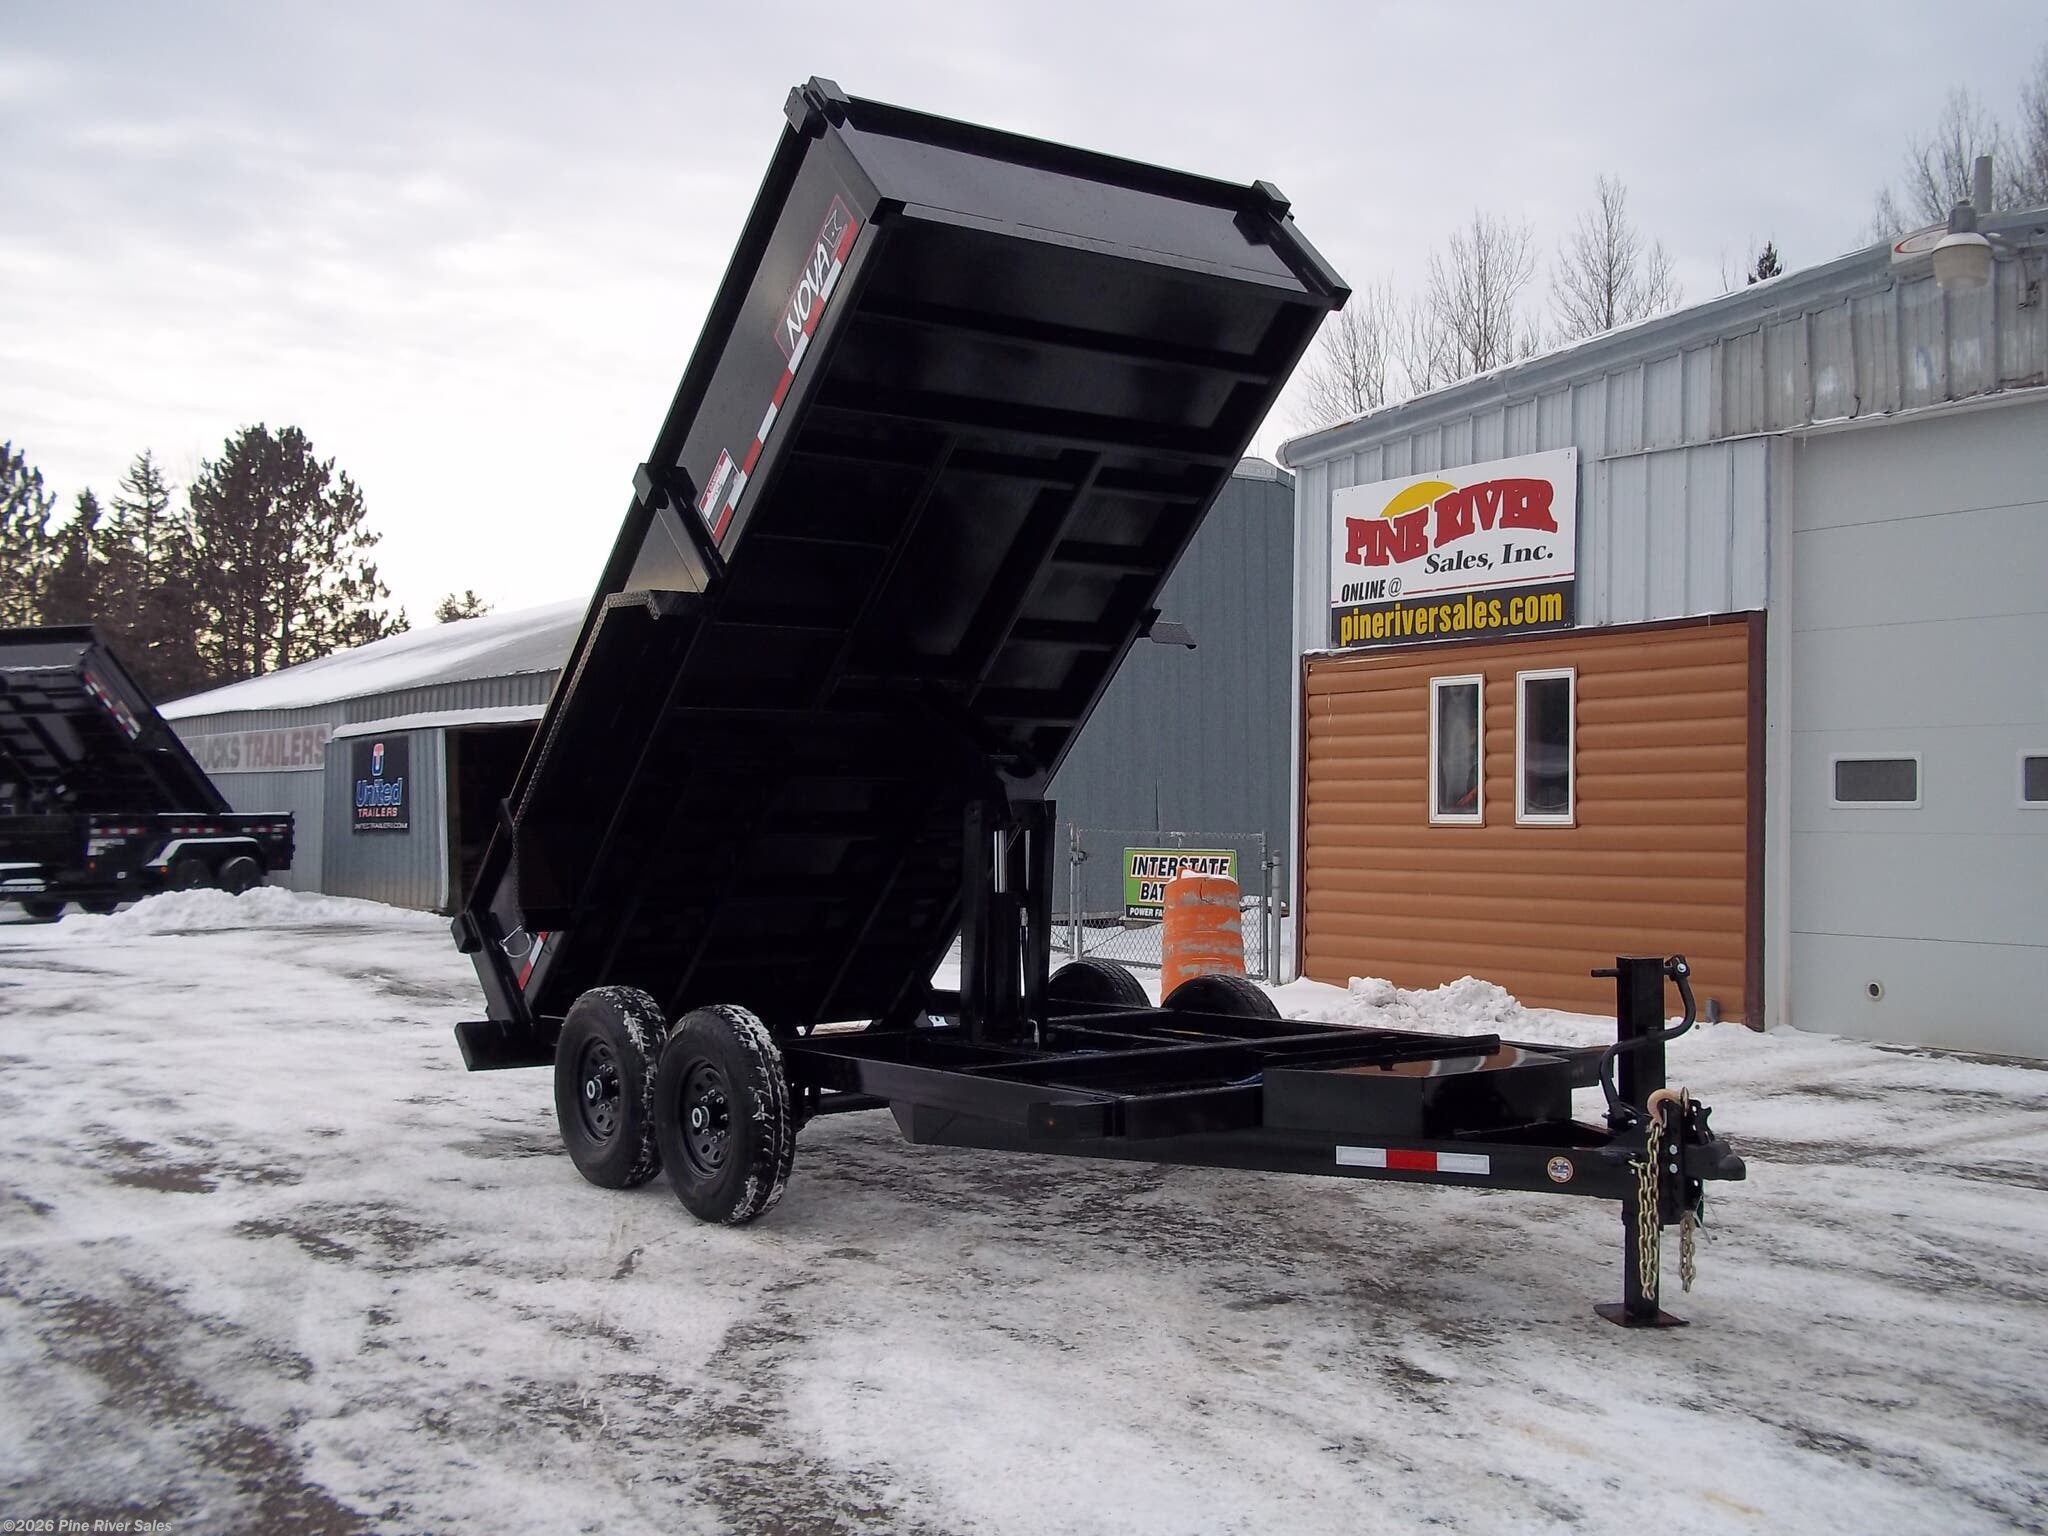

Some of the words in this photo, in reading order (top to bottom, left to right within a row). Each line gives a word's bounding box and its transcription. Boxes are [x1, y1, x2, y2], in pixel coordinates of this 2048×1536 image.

[787, 242, 830, 349] NOVA
[1345, 506, 1428, 567] PINE
[1434, 478, 1558, 548] RIVER
[1424, 550, 1494, 575] Sales,
[1501, 543, 1553, 565] Inc.
[1341, 580, 1386, 602] ONLINE
[1388, 577, 1402, 598] @
[1340, 592, 1562, 647] pineriversales.com
[245, 728, 326, 768] TRAILERS
[356, 778, 403, 807] United
[358, 807, 398, 818] TRAILERS
[1129, 907, 1154, 917] POWER
